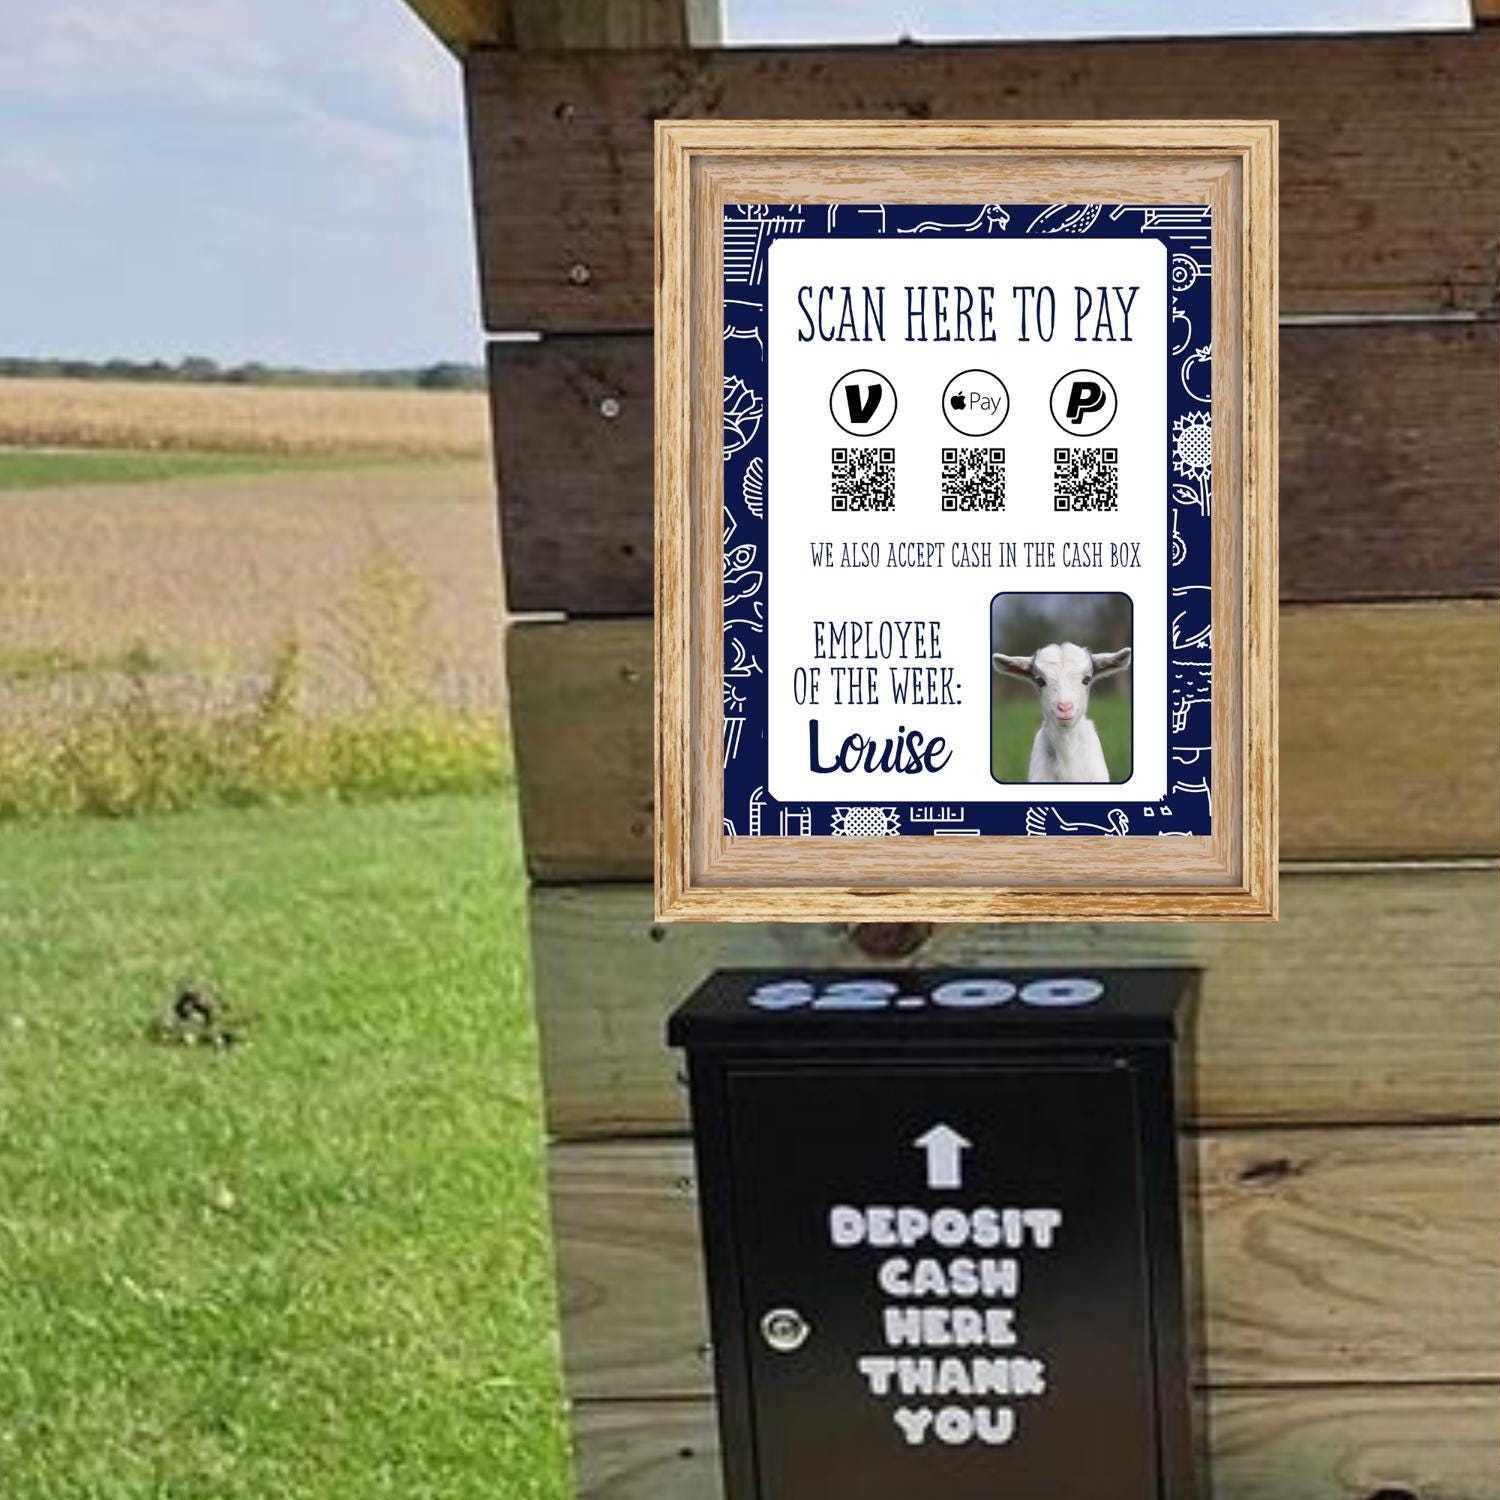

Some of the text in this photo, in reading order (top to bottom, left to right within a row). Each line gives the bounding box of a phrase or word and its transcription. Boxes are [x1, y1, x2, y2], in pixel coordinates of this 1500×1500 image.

[798, 286, 1140, 342] SCAN HERE TO PAY
[969, 391, 1002, 415] Pay
[810, 543, 1141, 567] WE ALSO ACCEPT CASH IN THE CASH BOX
[814, 621, 941, 659] EMPLOYEE
[794, 667, 961, 705] OF THE WEEK:
[809, 719, 953, 774] Louise
[831, 1206, 1061, 1247] DEPOSIT
[879, 1258, 1017, 1296] CASH
[885, 1308, 1016, 1346] HERE
[859, 1358, 1045, 1395] THANK
[894, 1406, 1013, 1444] YOU
